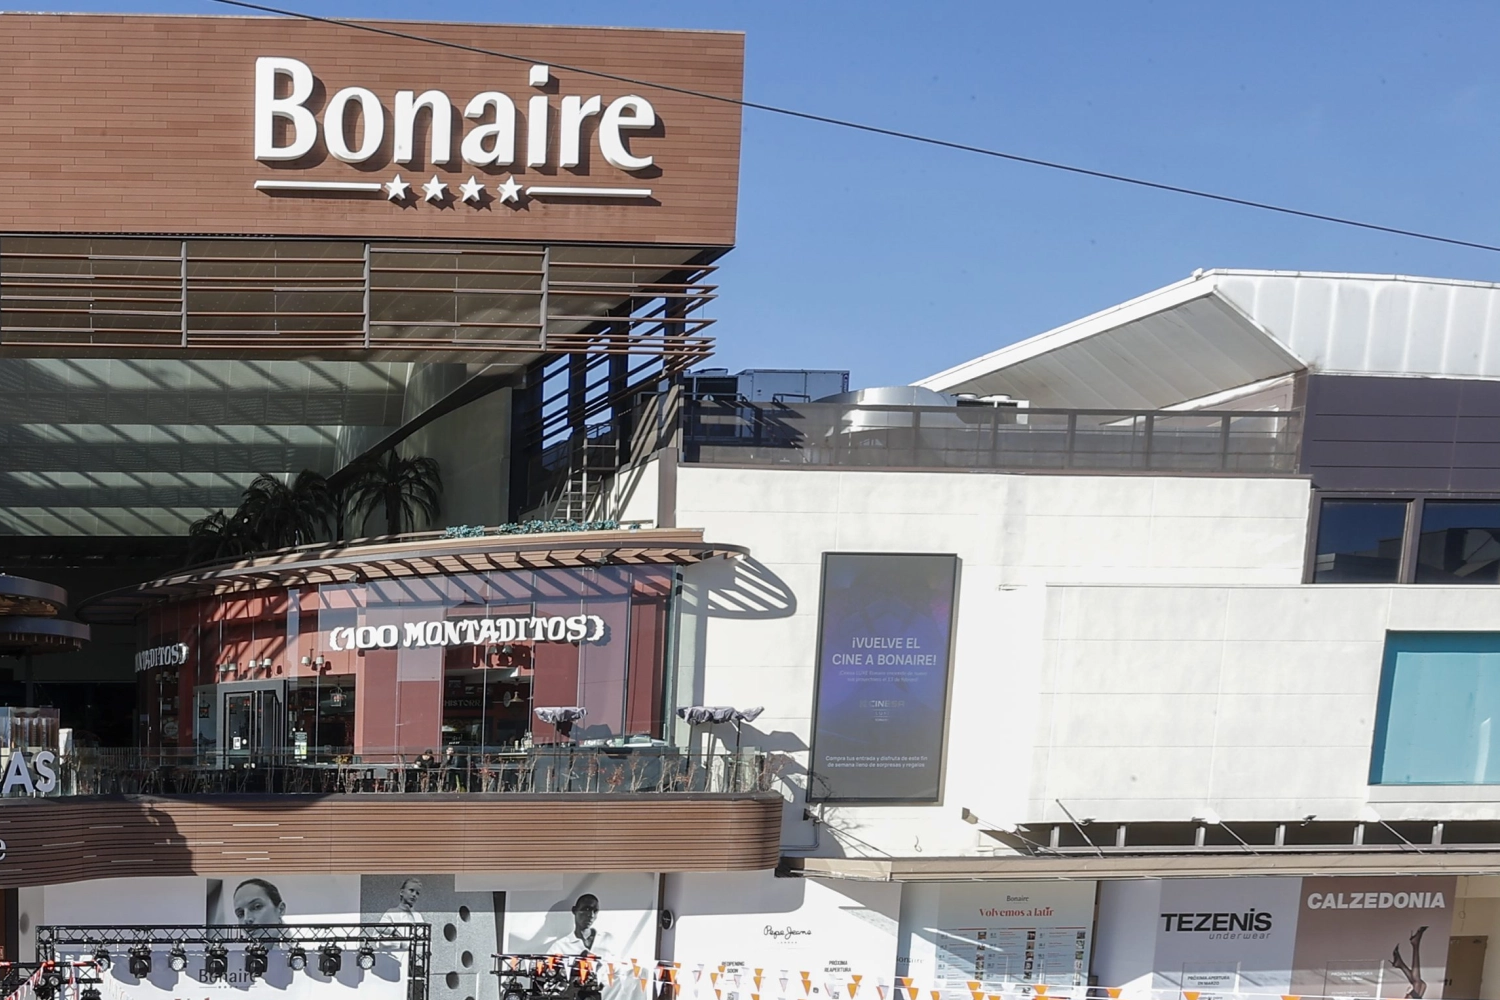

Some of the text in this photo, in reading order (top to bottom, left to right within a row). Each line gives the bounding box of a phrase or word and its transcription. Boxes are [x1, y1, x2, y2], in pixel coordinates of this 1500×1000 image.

[254, 56, 656, 171] Bonaire
[852, 637, 920, 649] ¡VUELVE EL
[832, 654, 937, 666] CINE A BONAIRE!
[1307, 892, 1446, 911] CALZEDONIA
[979, 908, 1025, 918] Volvemos
[1034, 906, 1054, 918] latir
[1209, 932, 1272, 940] underwear
[199, 968, 258, 983] Bonaire
